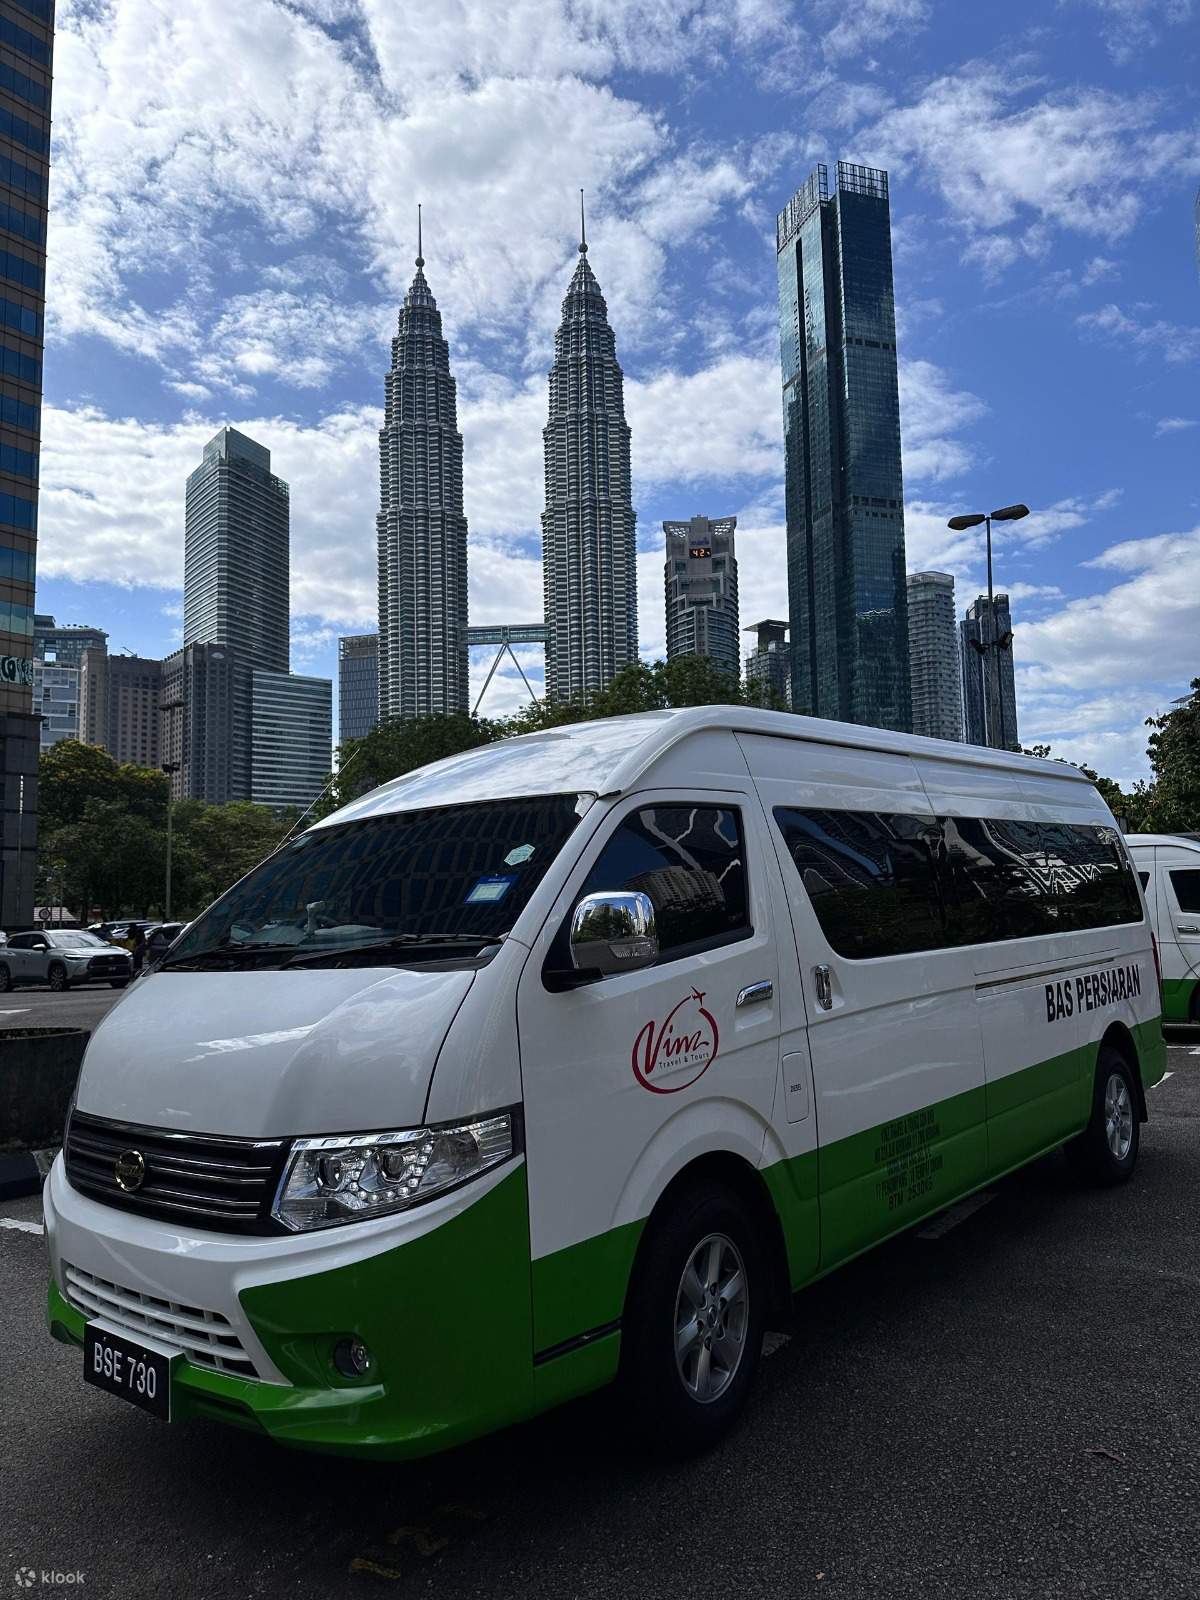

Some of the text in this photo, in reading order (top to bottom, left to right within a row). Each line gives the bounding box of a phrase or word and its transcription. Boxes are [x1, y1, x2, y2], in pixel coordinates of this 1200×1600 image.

[1045, 963, 1141, 1023] BAS PERSIARAN
[659, 1056, 682, 1069] Travel
[691, 1051, 710, 1062] Tours
[93, 1341, 157, 1399] BSE 730
